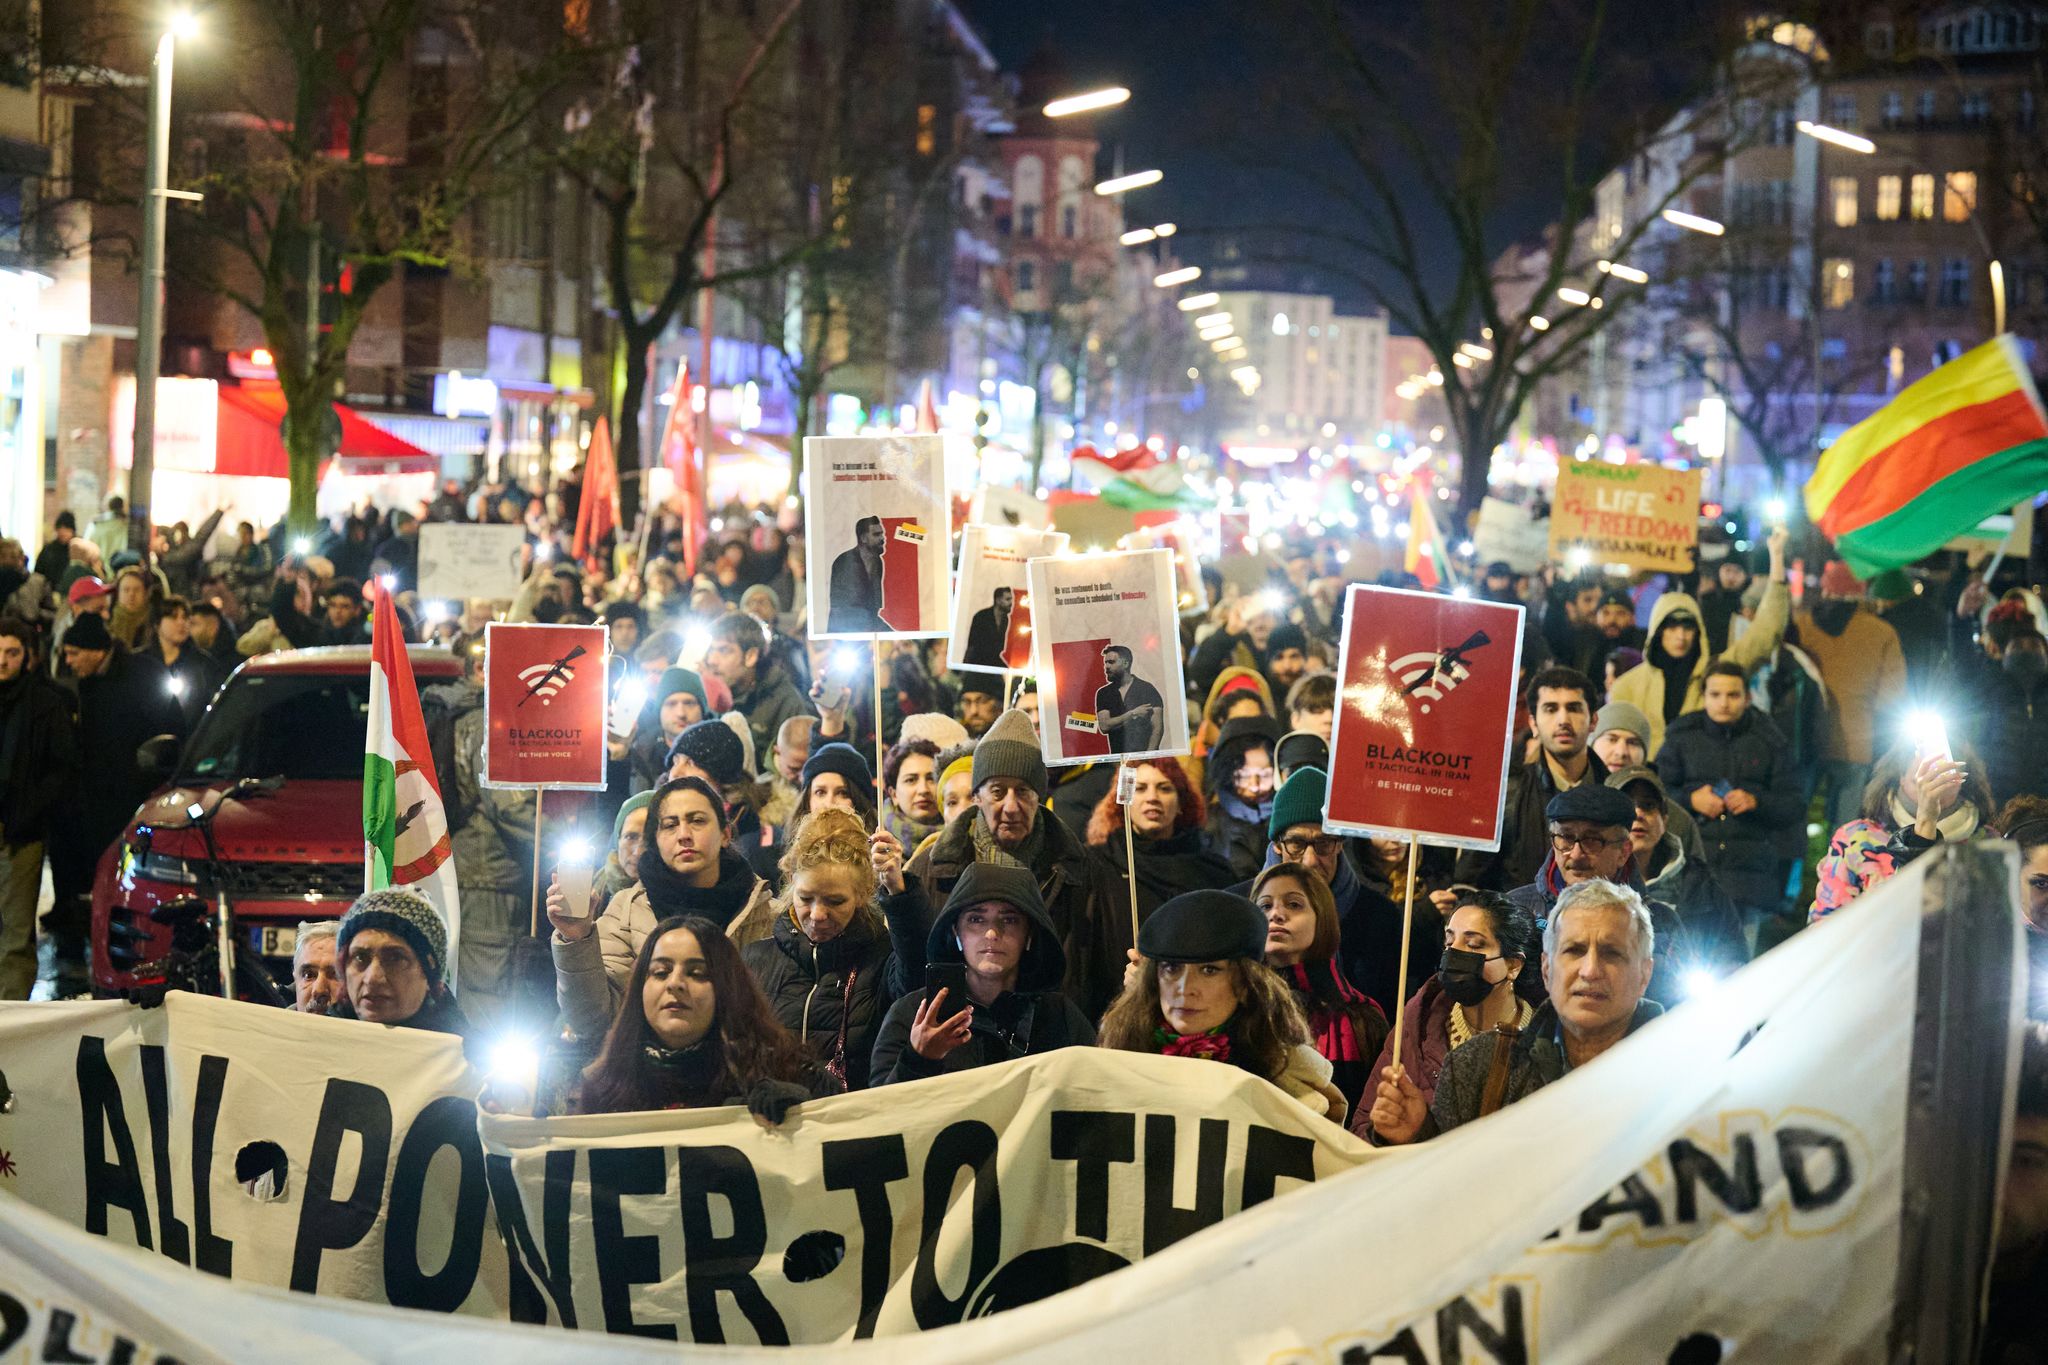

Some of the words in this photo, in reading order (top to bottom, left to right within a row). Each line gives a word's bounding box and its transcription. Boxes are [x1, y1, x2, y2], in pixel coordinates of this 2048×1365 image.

[1596, 488, 1656, 517] LIFE
[1582, 508, 1693, 545] FREEDOM
[509, 728, 582, 739] BLACKOUT
[1366, 744, 1473, 770] BLACKOUT
[1365, 761, 1375, 769] IS
[1379, 763, 1427, 775] TACTICAL
[1431, 769, 1442, 778] IN
[1445, 771, 1471, 781] IRAN
[1377, 780, 1390, 789] BE
[1394, 782, 1421, 792] THEIR
[1425, 786, 1454, 797] VOICE
[76, 1035, 233, 1280] ALL
[822, 1119, 999, 1341] TO
[1542, 1127, 1853, 1241] AND
